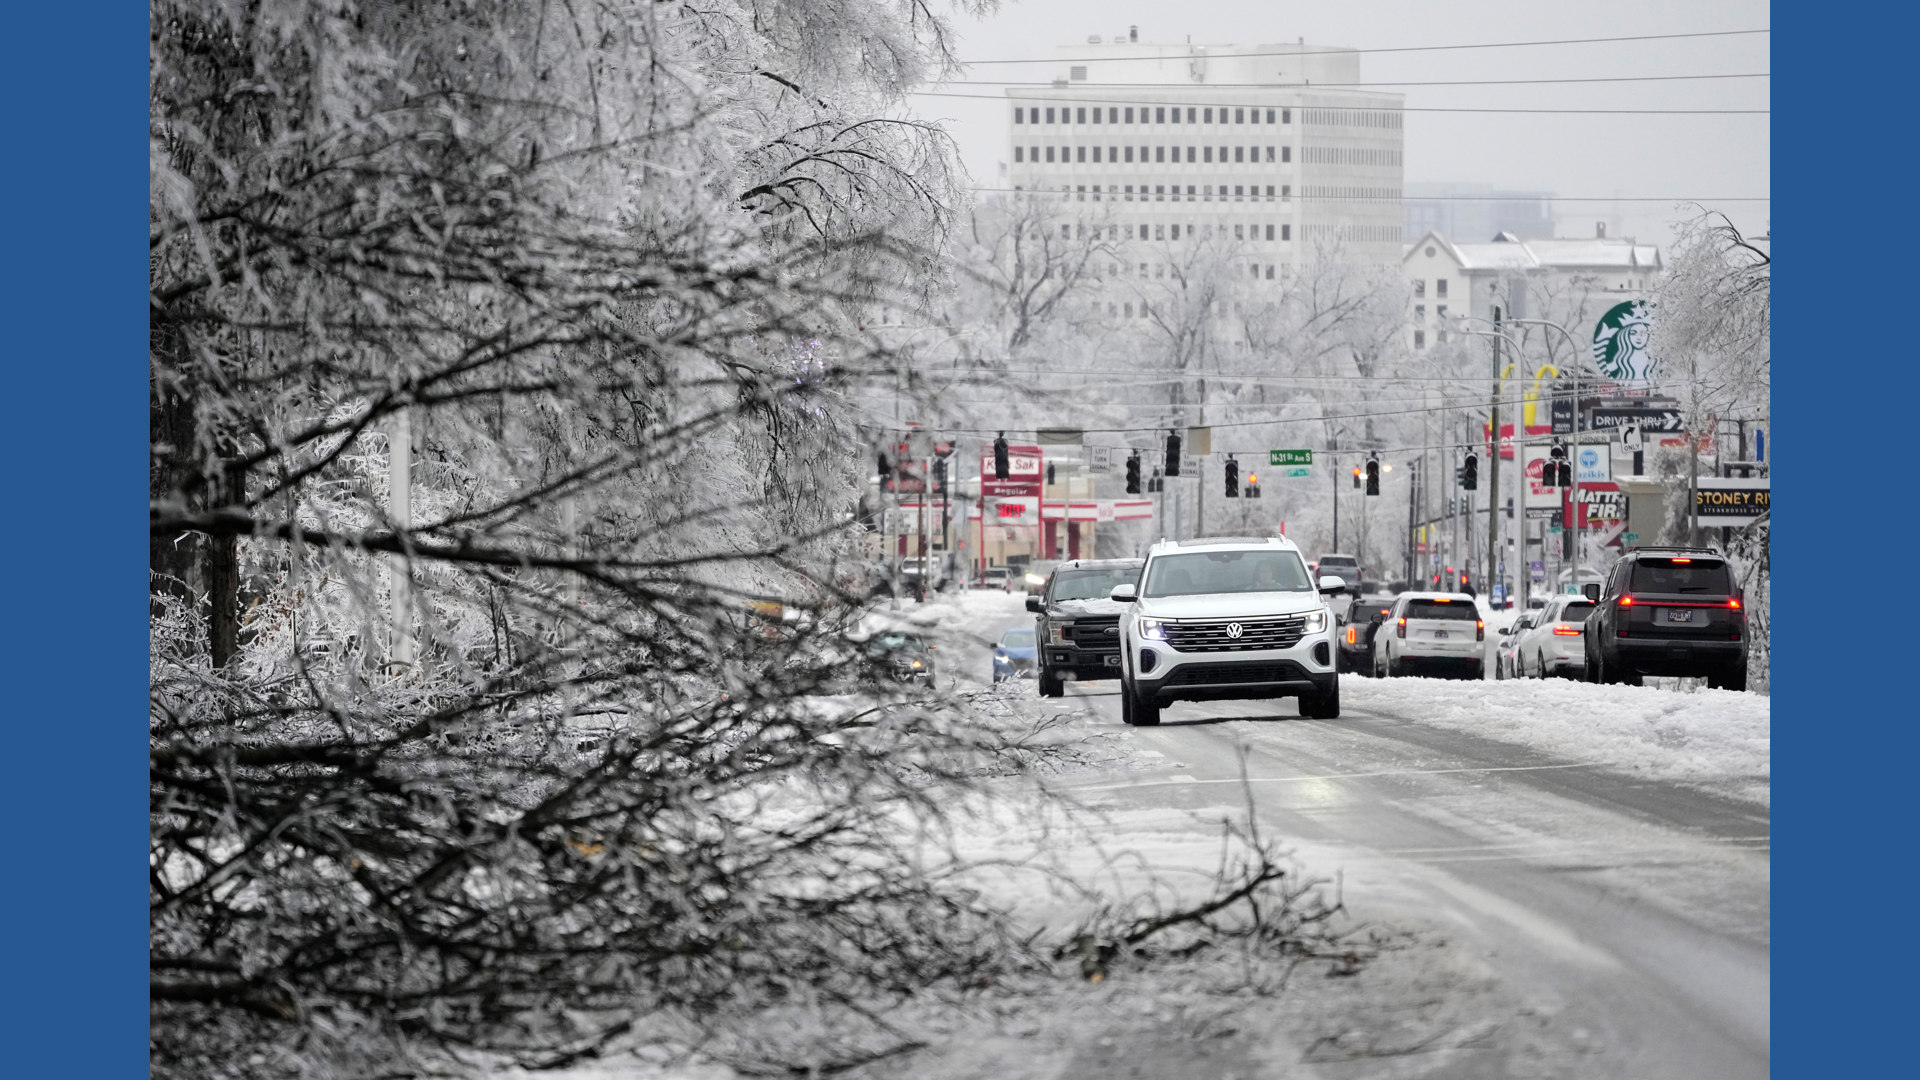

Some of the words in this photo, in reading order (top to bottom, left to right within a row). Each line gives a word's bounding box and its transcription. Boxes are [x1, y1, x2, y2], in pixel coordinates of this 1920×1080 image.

[1596, 415, 1629, 426] DRIVE
[1632, 416, 1662, 426] THRU
[1624, 443, 1640, 451] ONLY
[1305, 452, 1311, 462] S
[1015, 458, 1035, 470] Sak
[994, 487, 1028, 495] Regular
[1696, 491, 1751, 505] STONEY
[1755, 492, 1770, 505] RI
